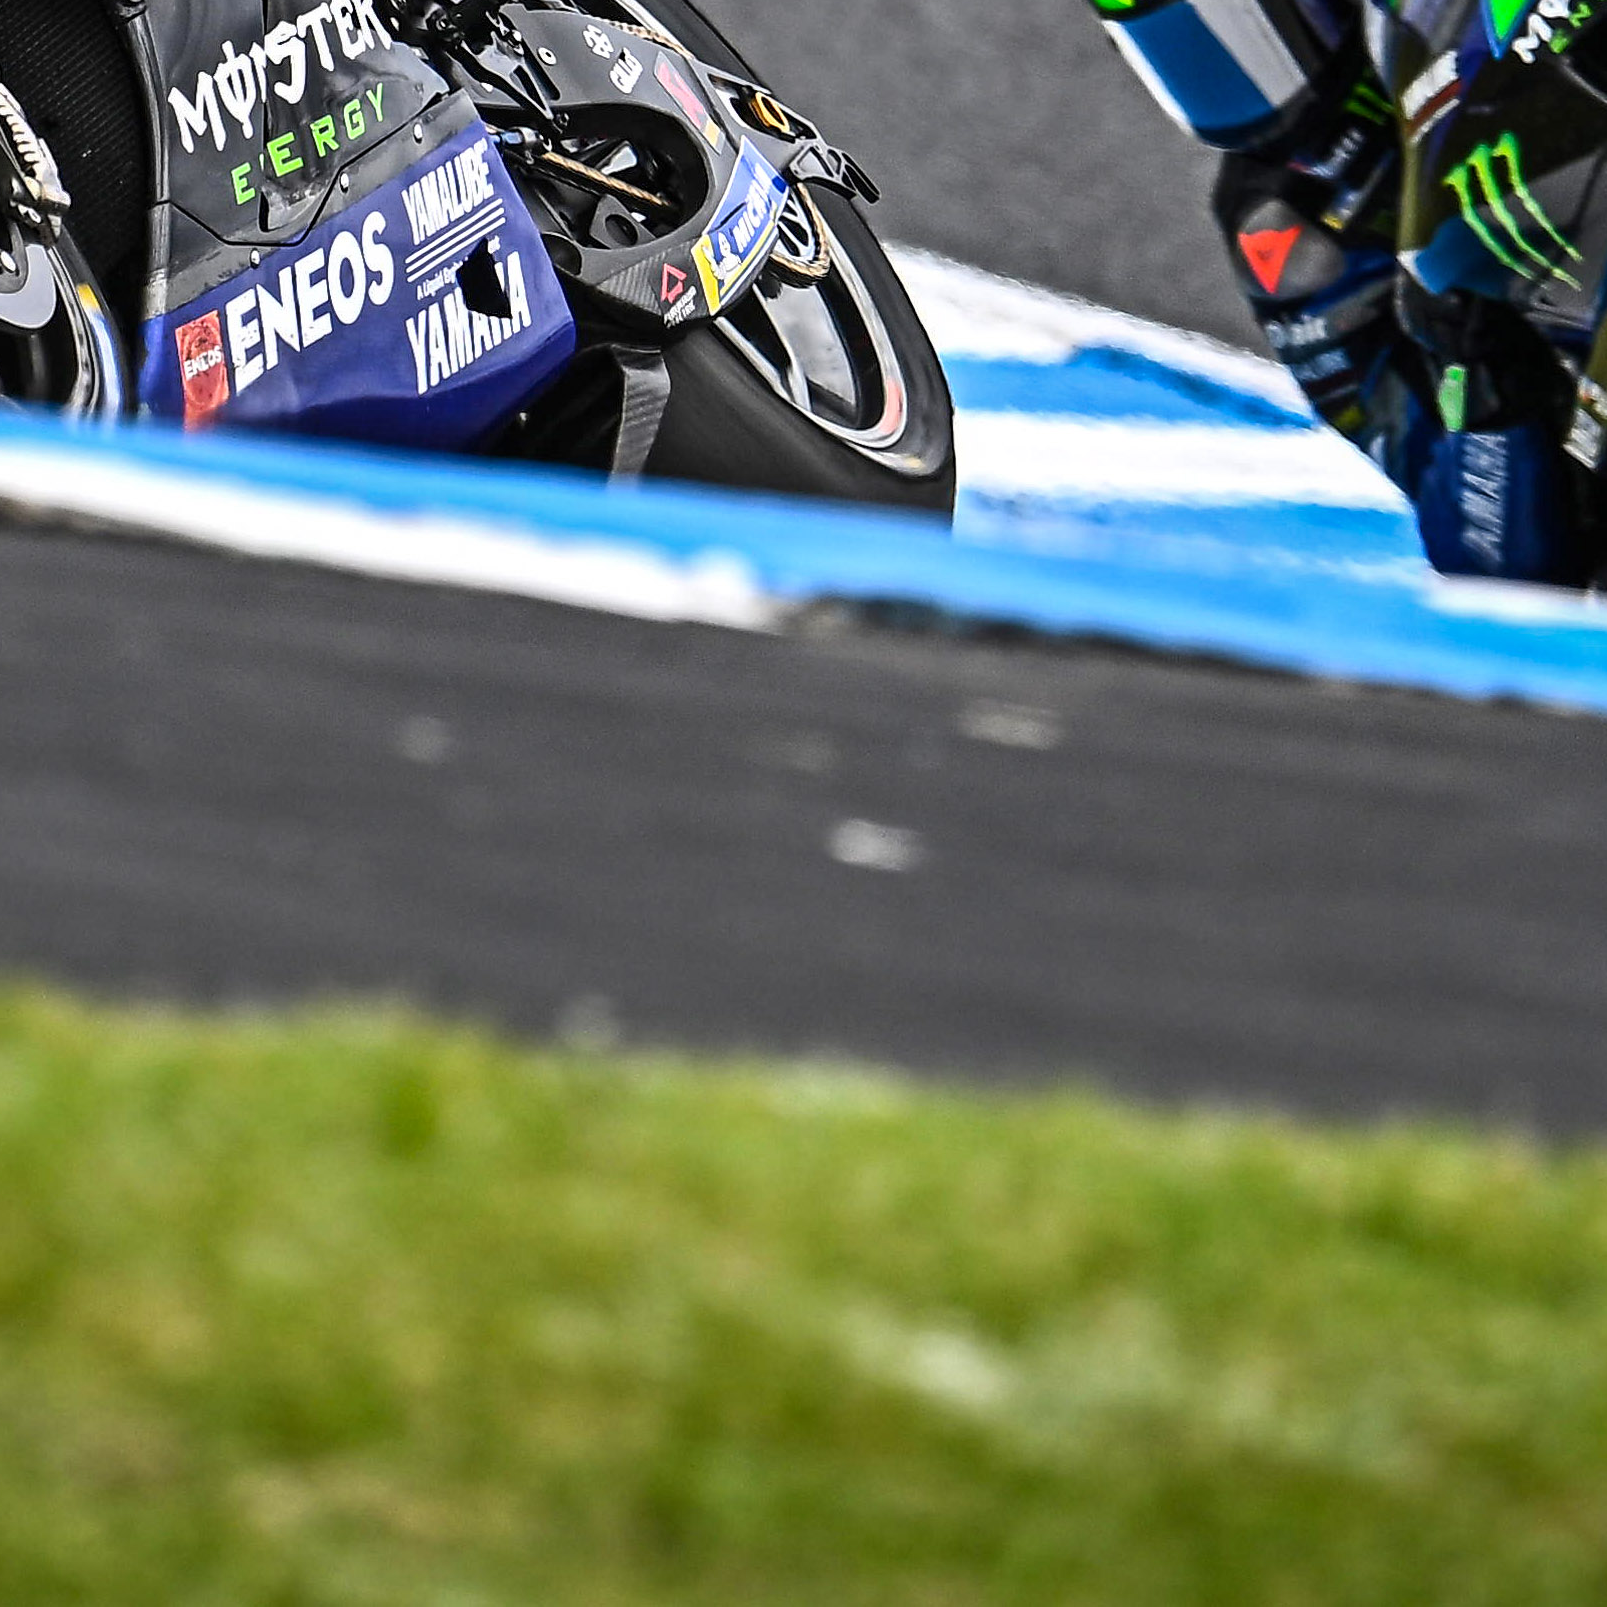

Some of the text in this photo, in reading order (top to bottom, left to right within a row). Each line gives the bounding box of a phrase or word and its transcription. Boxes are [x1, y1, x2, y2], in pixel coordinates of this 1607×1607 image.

[231, 82, 383, 205] EERGY
[401, 137, 495, 246] YAMALUBE
[225, 211, 395, 396] ENEOS
